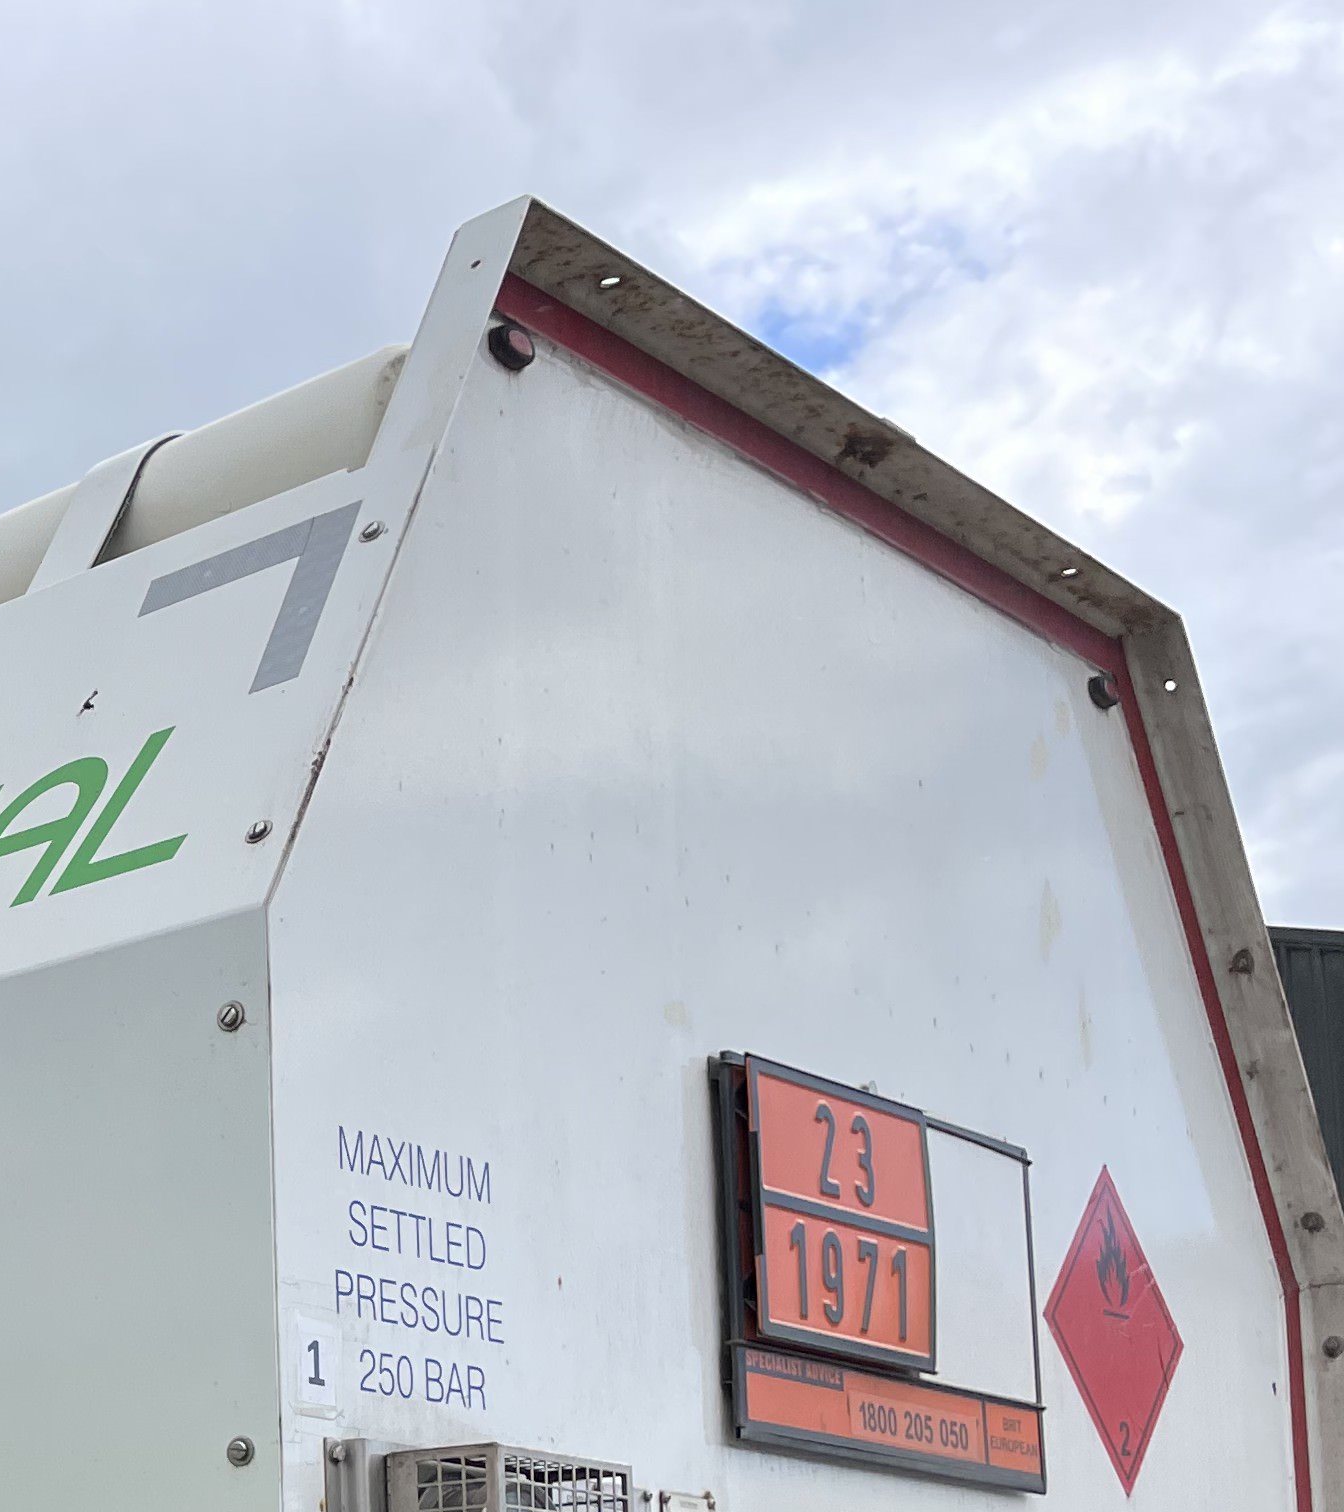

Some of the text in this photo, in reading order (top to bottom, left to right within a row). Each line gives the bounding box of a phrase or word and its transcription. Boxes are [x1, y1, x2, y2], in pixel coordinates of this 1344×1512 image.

[338, 1125, 491, 1204] MAXIMUM
[815, 1101, 875, 1207] 23
[348, 1199, 486, 1270] SETTLED
[334, 1268, 505, 1345] PRESSURE
[789, 1218, 907, 1342] 1971
[307, 1340, 326, 1387] 1
[359, 1348, 487, 1411] 250 BAR
[745, 1352, 842, 1385] SPECIALIST ADVICE
[858, 1401, 969, 1451] 1800 205 050
[989, 1435, 1039, 1459] EUROPEAN
[1119, 1421, 1131, 1457] 2
